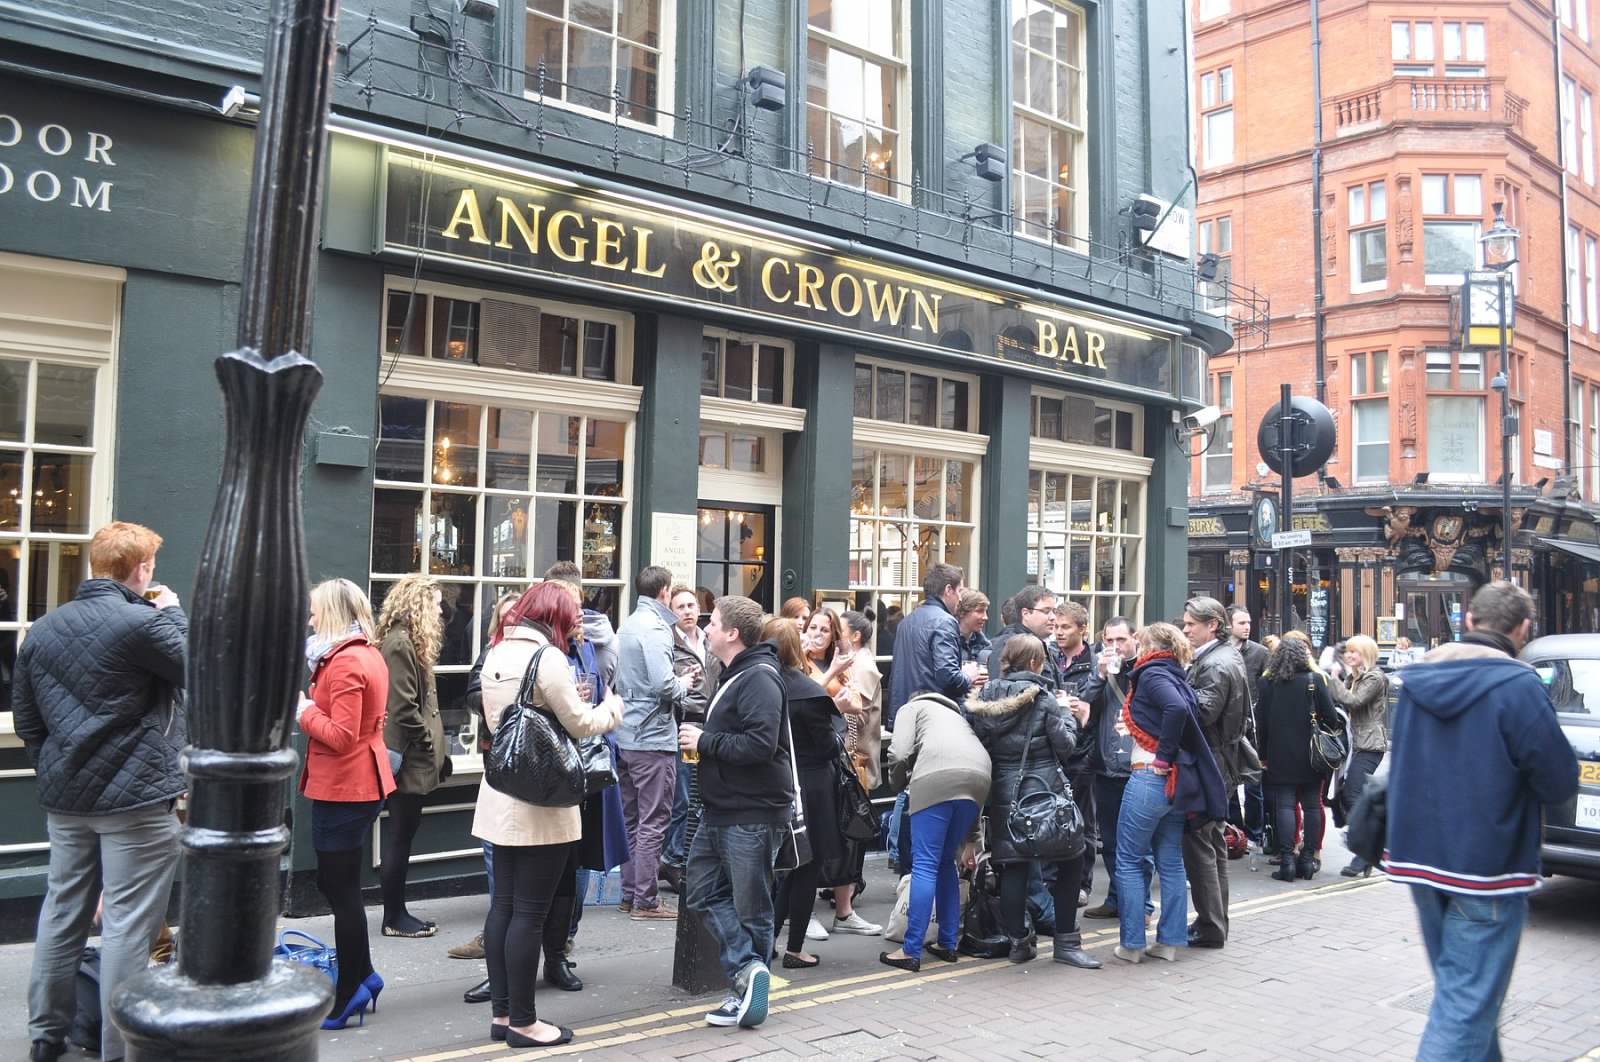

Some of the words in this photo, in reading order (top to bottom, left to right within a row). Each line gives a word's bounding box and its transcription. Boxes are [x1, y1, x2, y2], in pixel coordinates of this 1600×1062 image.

[441, 188, 667, 279] ANGEL
[691, 241, 741, 294] &
[761, 256, 943, 335] CROWN
[1035, 318, 1108, 369] BAR
